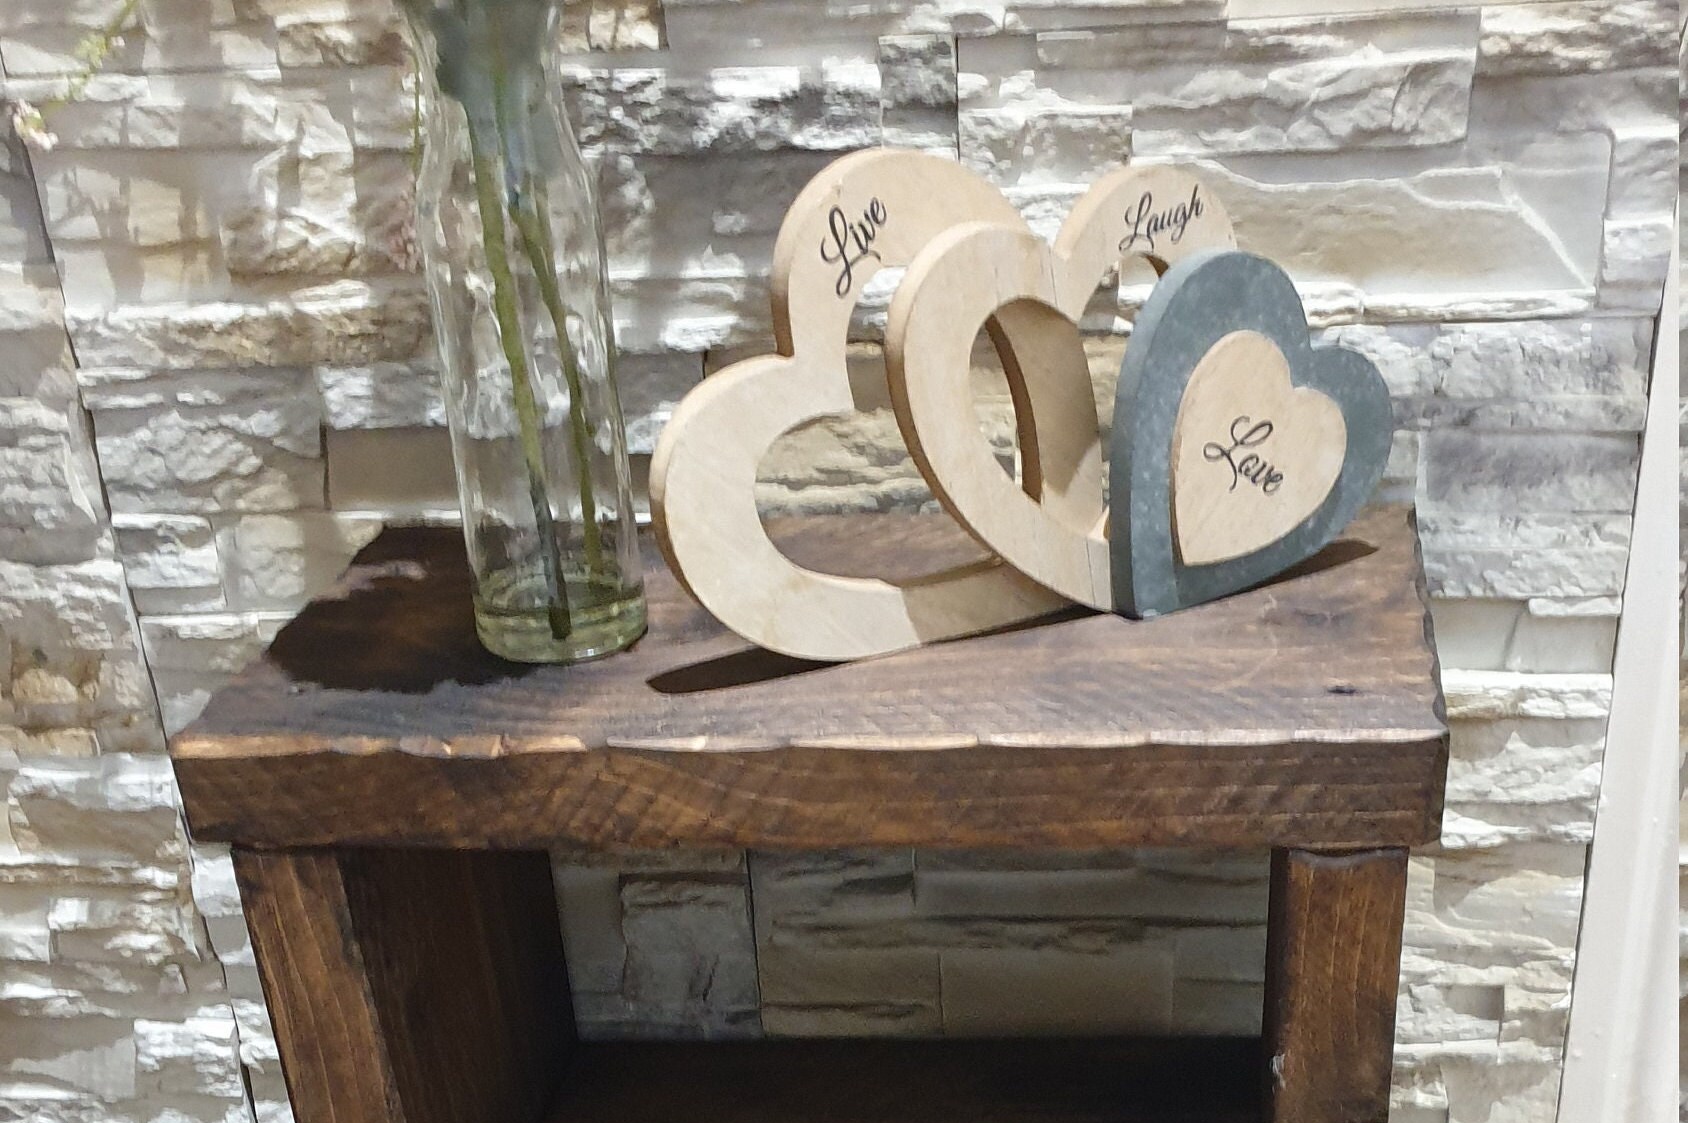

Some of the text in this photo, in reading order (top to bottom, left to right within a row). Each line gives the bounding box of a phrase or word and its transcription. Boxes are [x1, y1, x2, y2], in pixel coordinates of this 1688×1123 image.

[820, 196, 887, 299] Live
[1118, 183, 1204, 253] Laugh
[1203, 415, 1284, 495] Love
